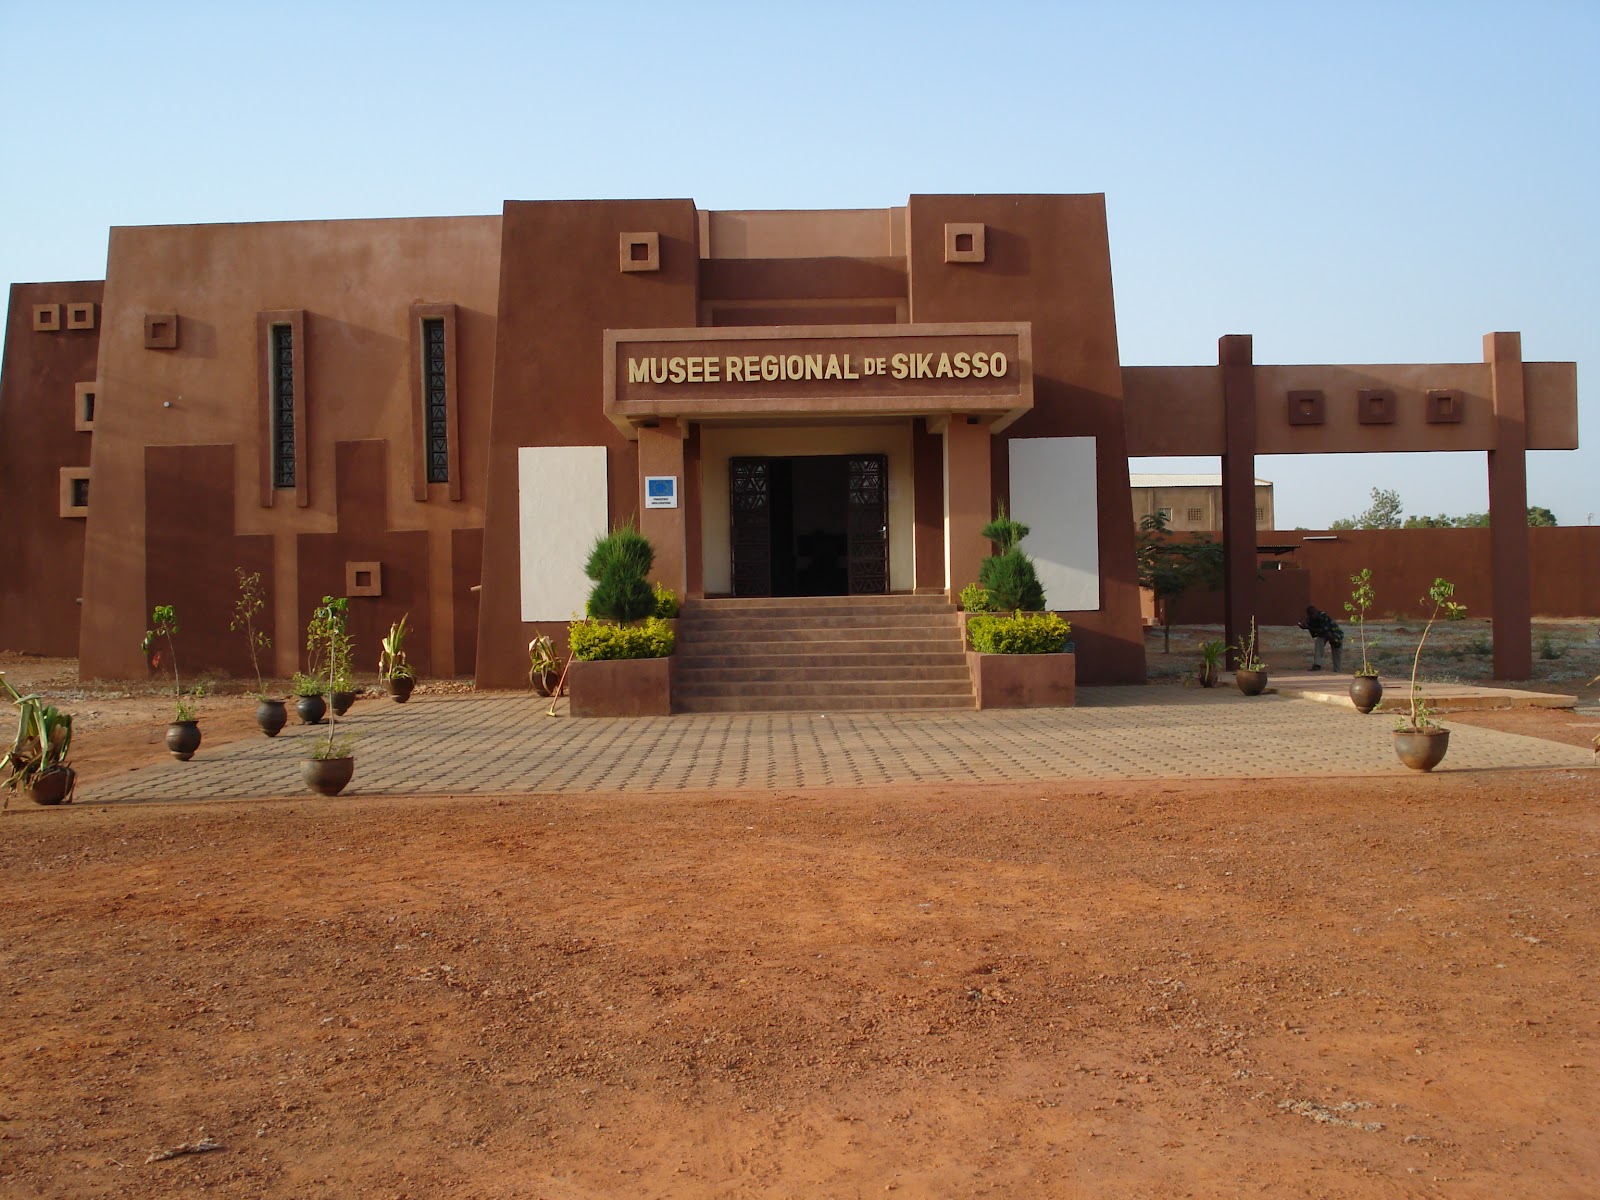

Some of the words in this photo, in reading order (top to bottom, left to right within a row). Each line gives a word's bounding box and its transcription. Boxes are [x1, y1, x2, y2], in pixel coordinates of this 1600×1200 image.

[628, 356, 720, 384] MUSEE
[725, 353, 860, 382] REGIONAL
[863, 357, 887, 375] DE
[891, 351, 1007, 379] SIKASSO
